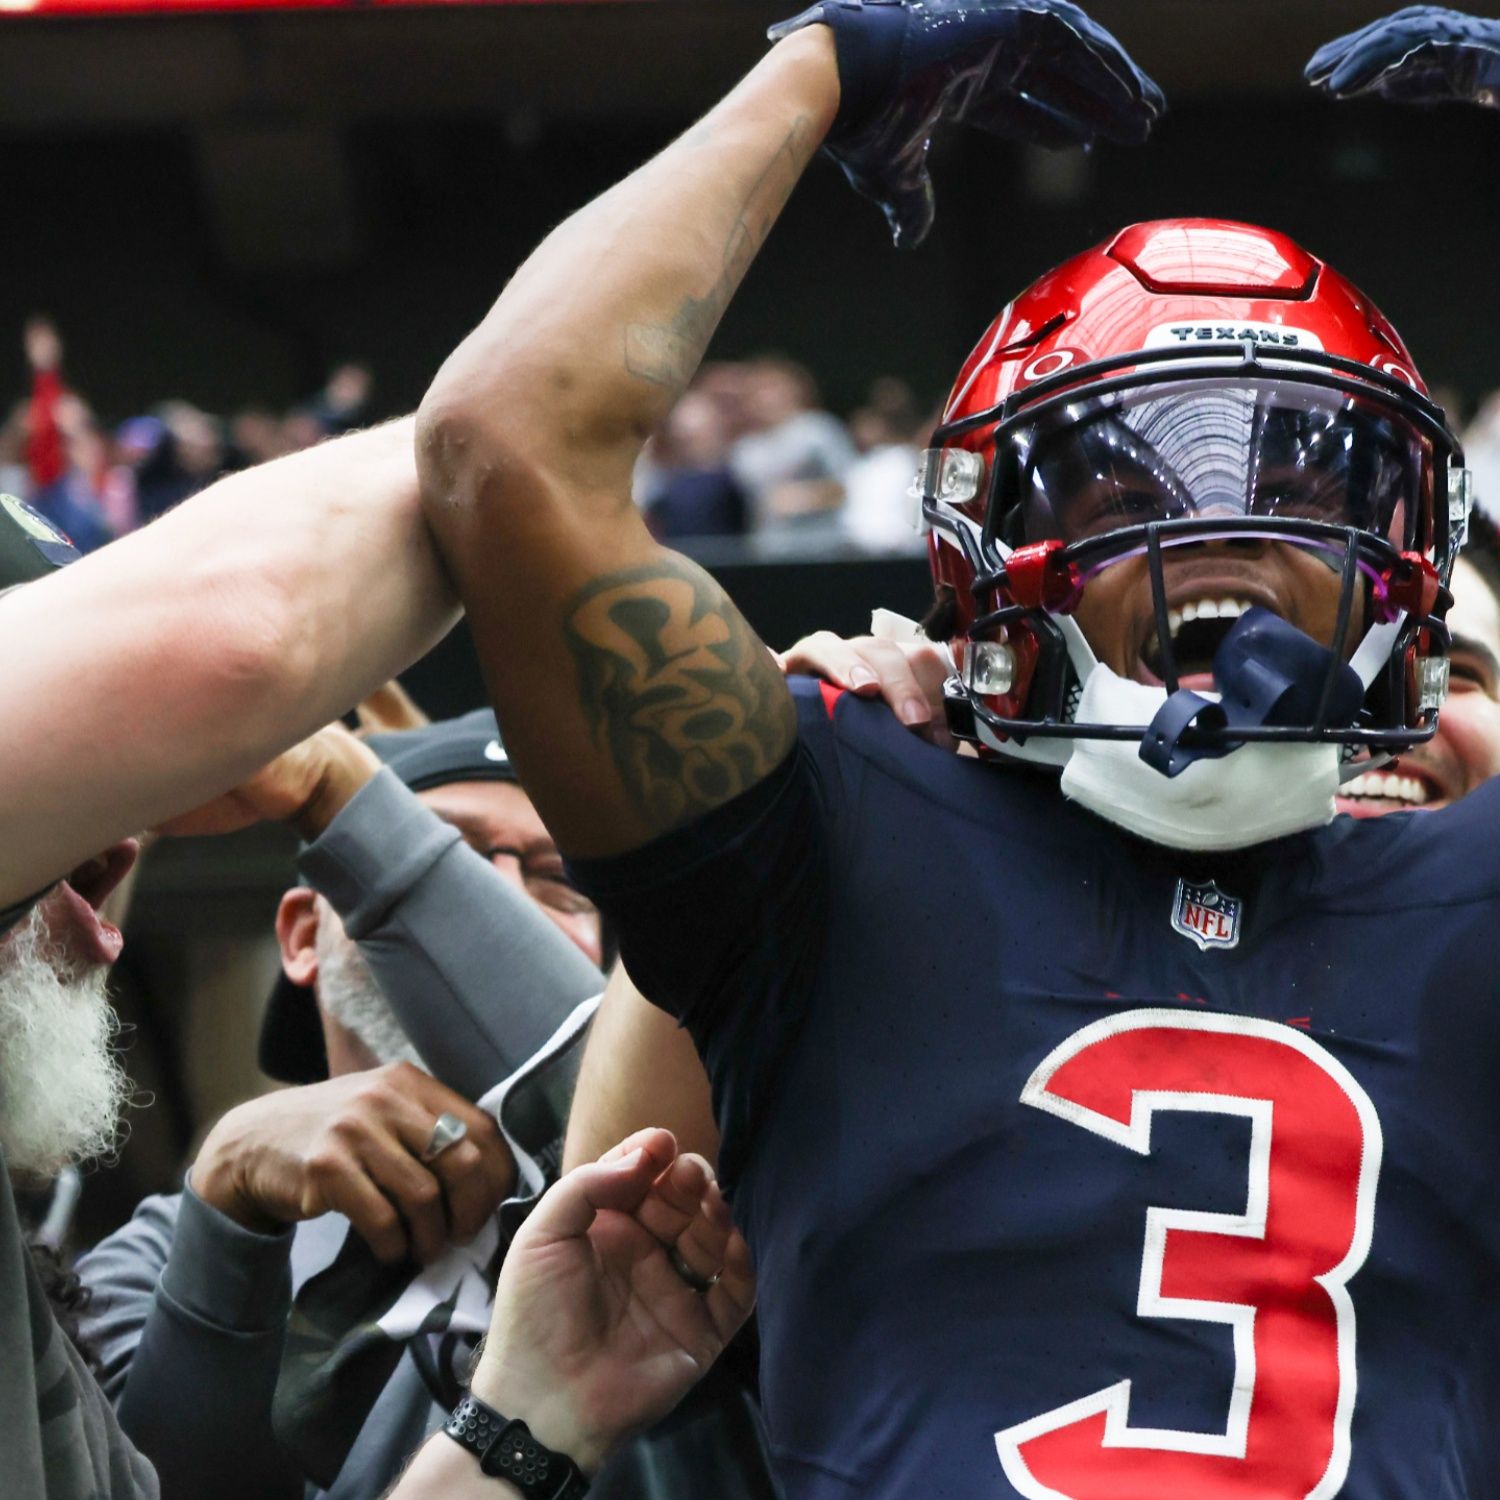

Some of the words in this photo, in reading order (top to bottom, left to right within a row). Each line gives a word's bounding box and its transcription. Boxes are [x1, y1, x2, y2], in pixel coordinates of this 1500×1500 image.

[1170, 326, 1299, 346] TEXANS
[1184, 901, 1229, 938] NFL
[995, 1008, 1384, 1500] 3
